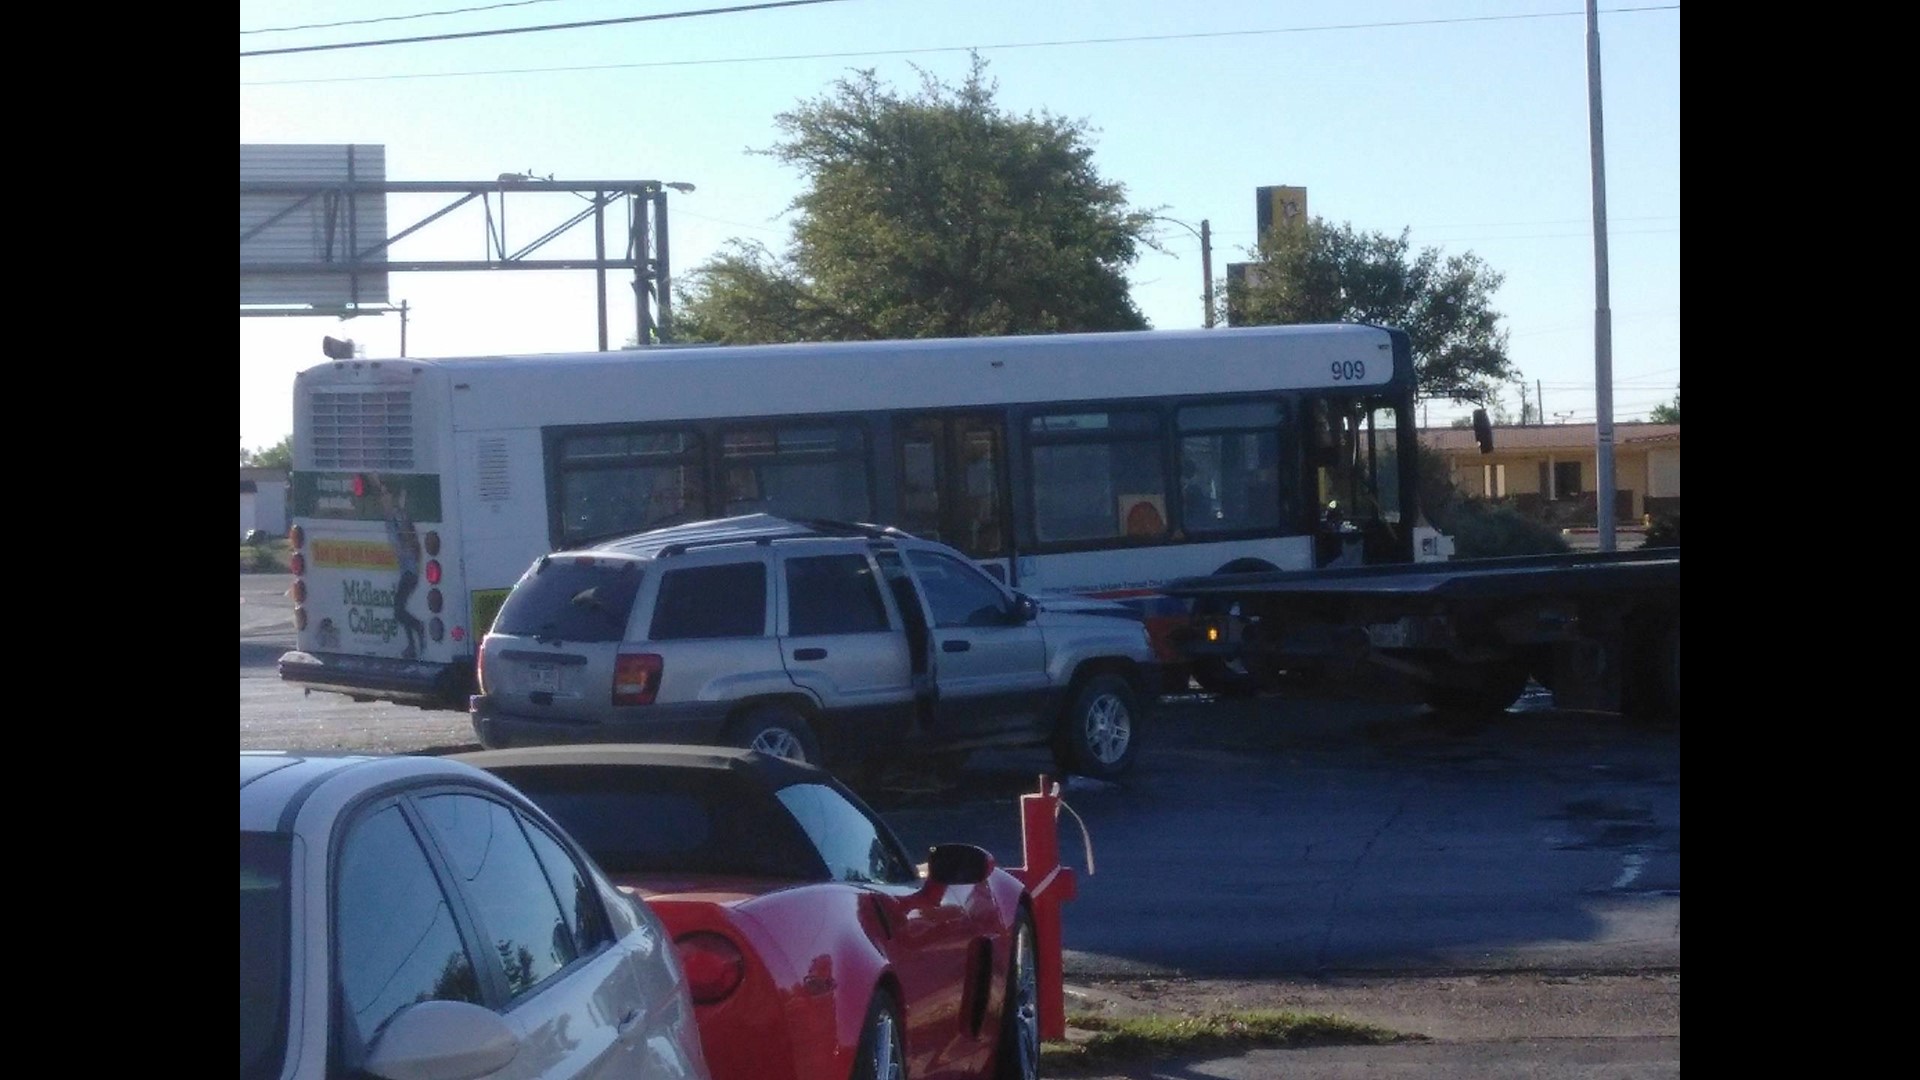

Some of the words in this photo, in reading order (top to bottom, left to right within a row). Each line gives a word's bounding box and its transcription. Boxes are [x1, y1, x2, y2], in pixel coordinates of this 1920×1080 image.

[1331, 360, 1366, 380] 909
[342, 579, 398, 608] Midland
[348, 607, 398, 644] College
